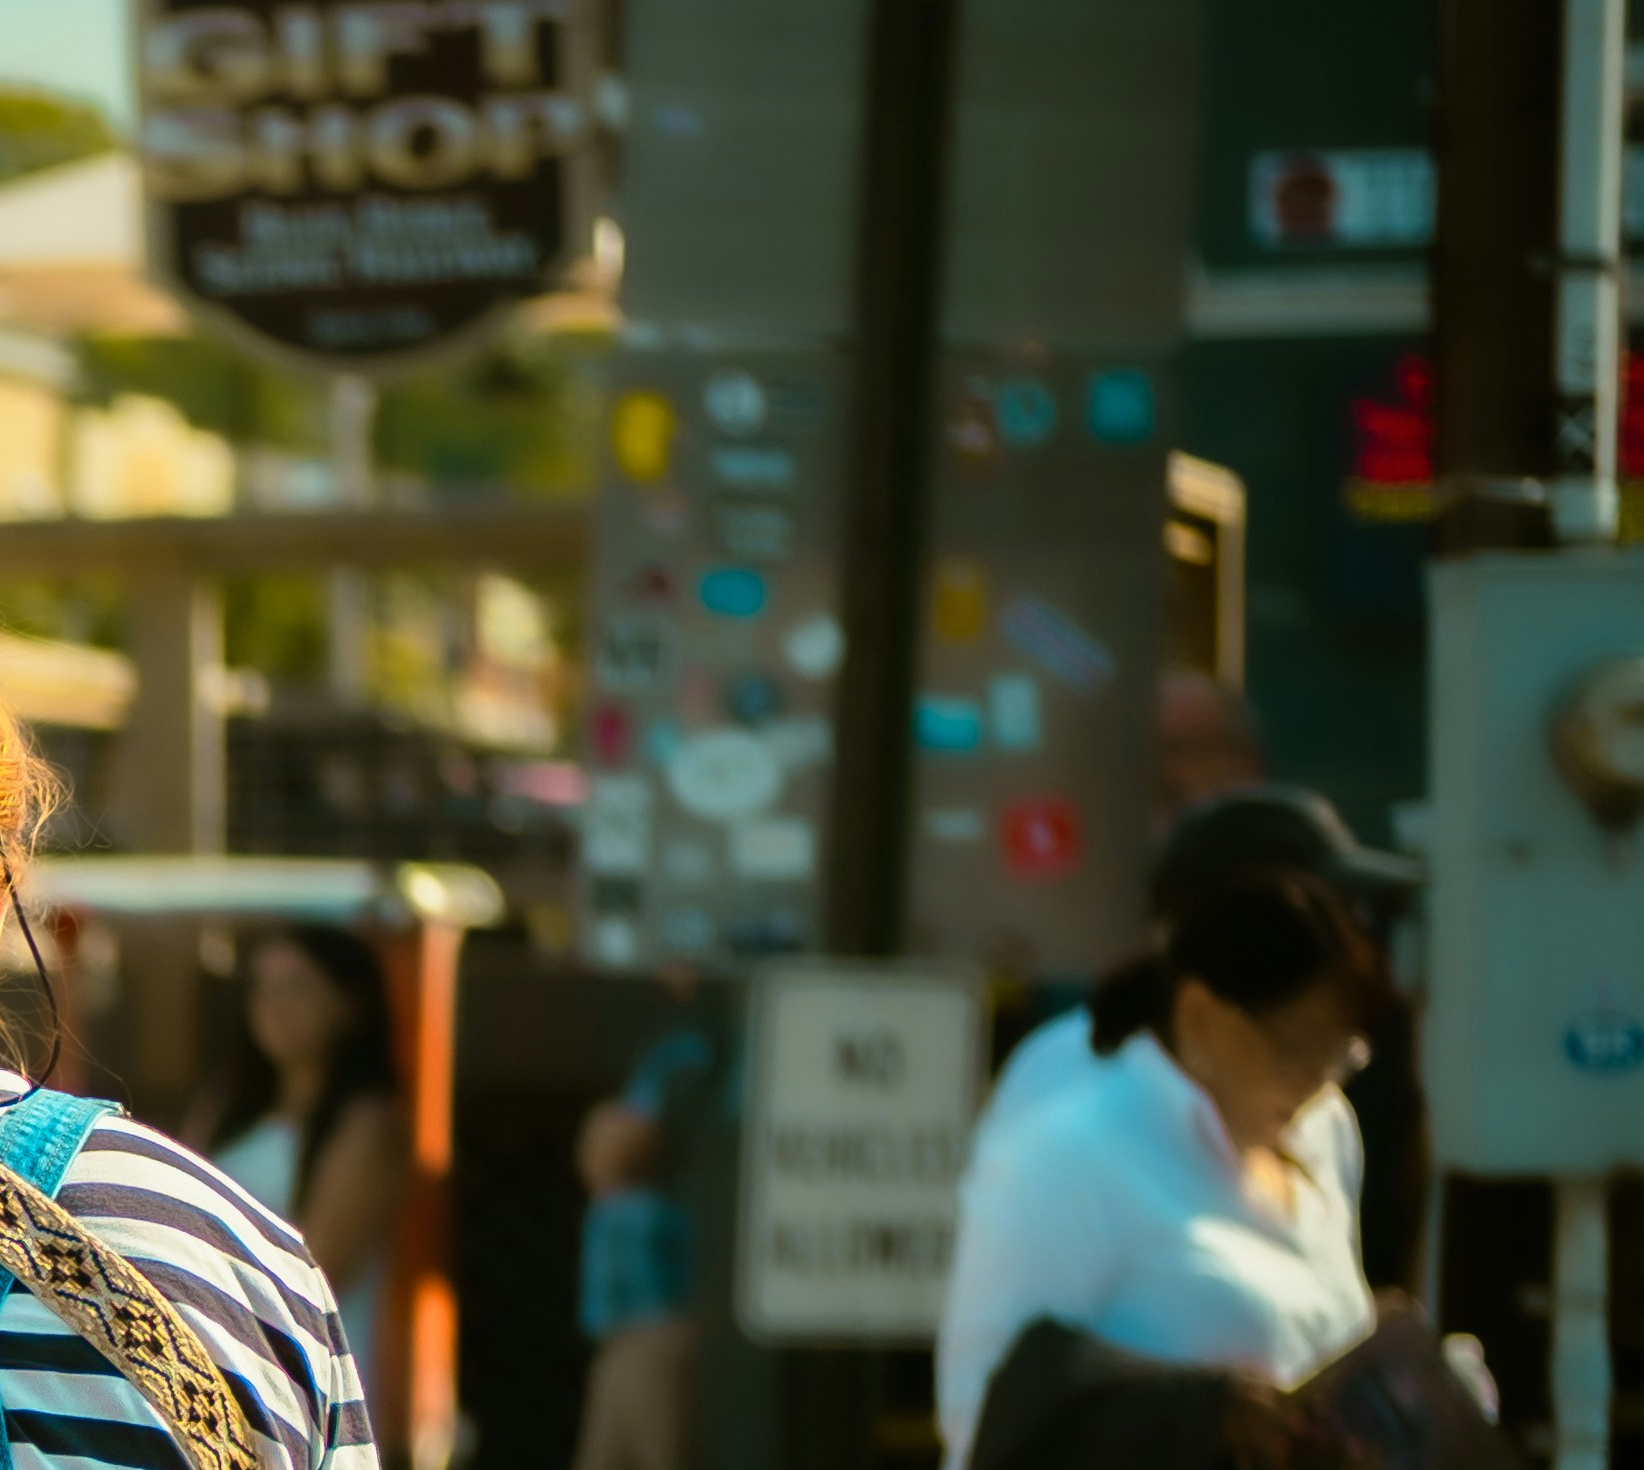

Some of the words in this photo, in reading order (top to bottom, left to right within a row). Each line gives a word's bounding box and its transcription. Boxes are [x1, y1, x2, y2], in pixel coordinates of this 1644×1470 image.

[143, 0, 567, 97] GIFT
[143, 92, 589, 198] SHOP
[833, 1028, 906, 1092] NO
